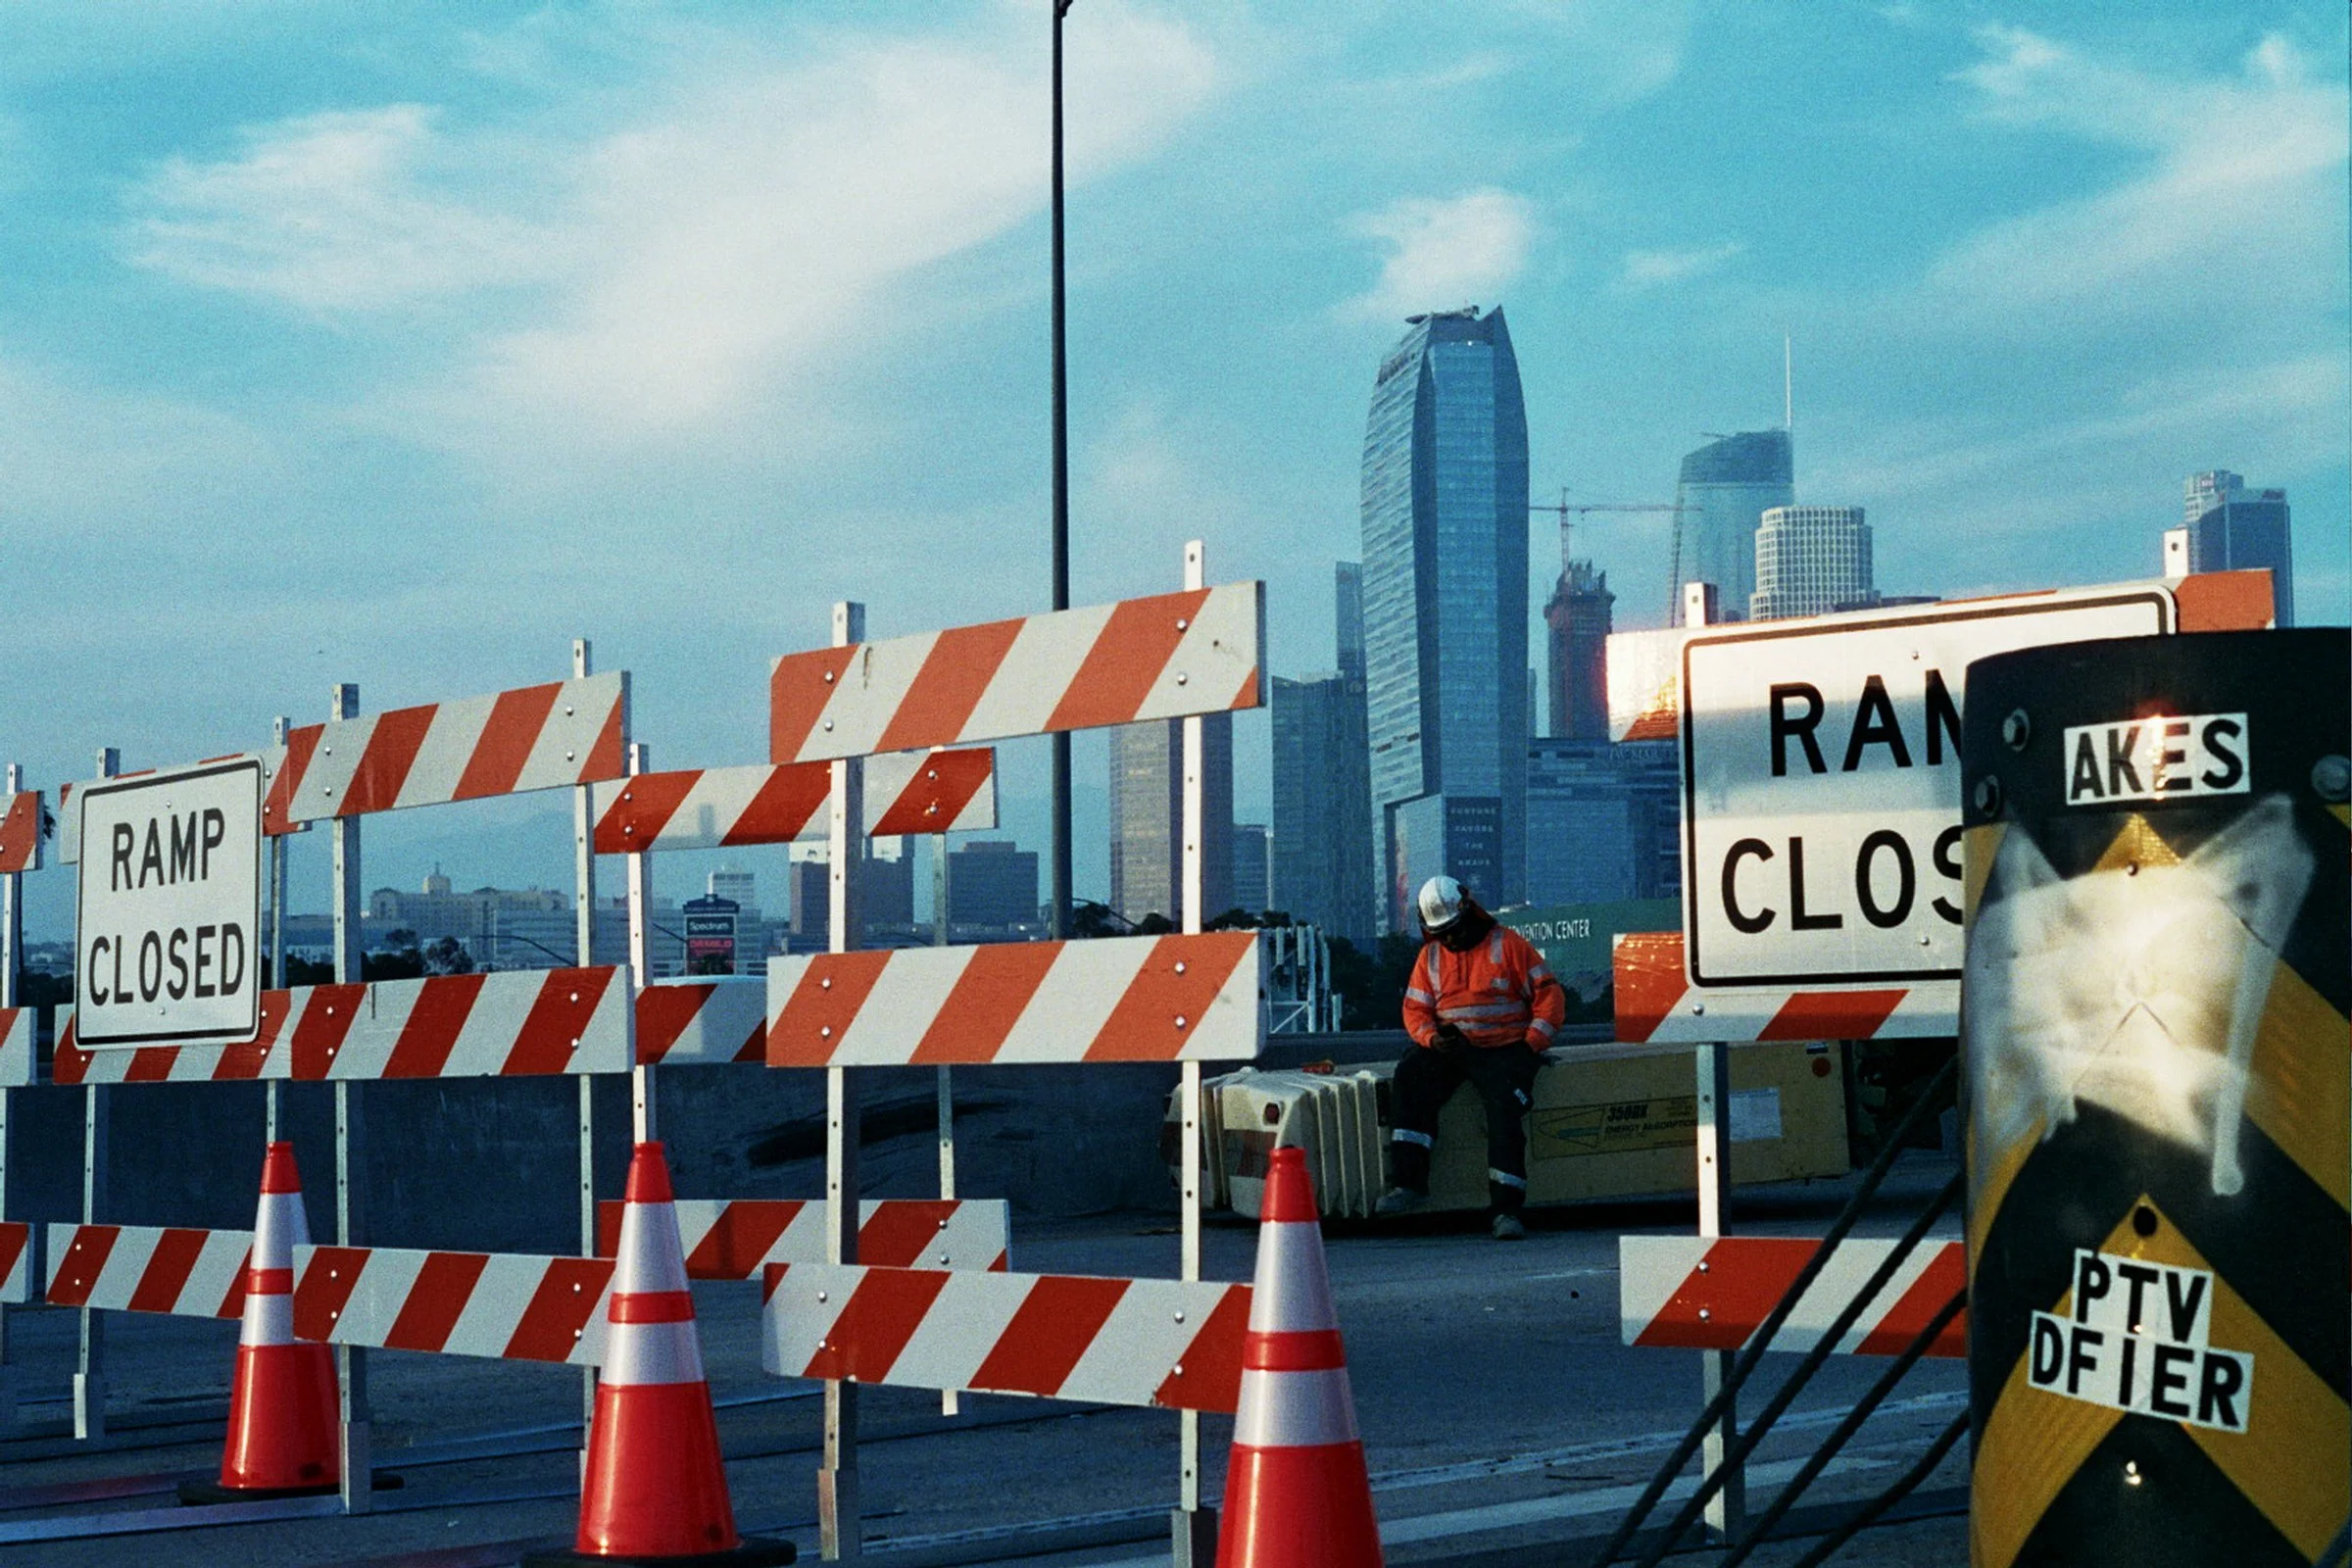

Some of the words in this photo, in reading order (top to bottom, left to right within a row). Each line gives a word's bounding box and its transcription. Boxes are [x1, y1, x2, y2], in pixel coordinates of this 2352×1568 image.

[2070, 717, 2243, 801] AKES
[112, 808, 225, 892] RAMP
[1721, 824, 1963, 934] CLOS
[88, 922, 245, 1006] CLOSED
[689, 921, 730, 932] Spectrum
[1555, 918, 1591, 940] CENTER
[2076, 1255, 2207, 1344] PTV
